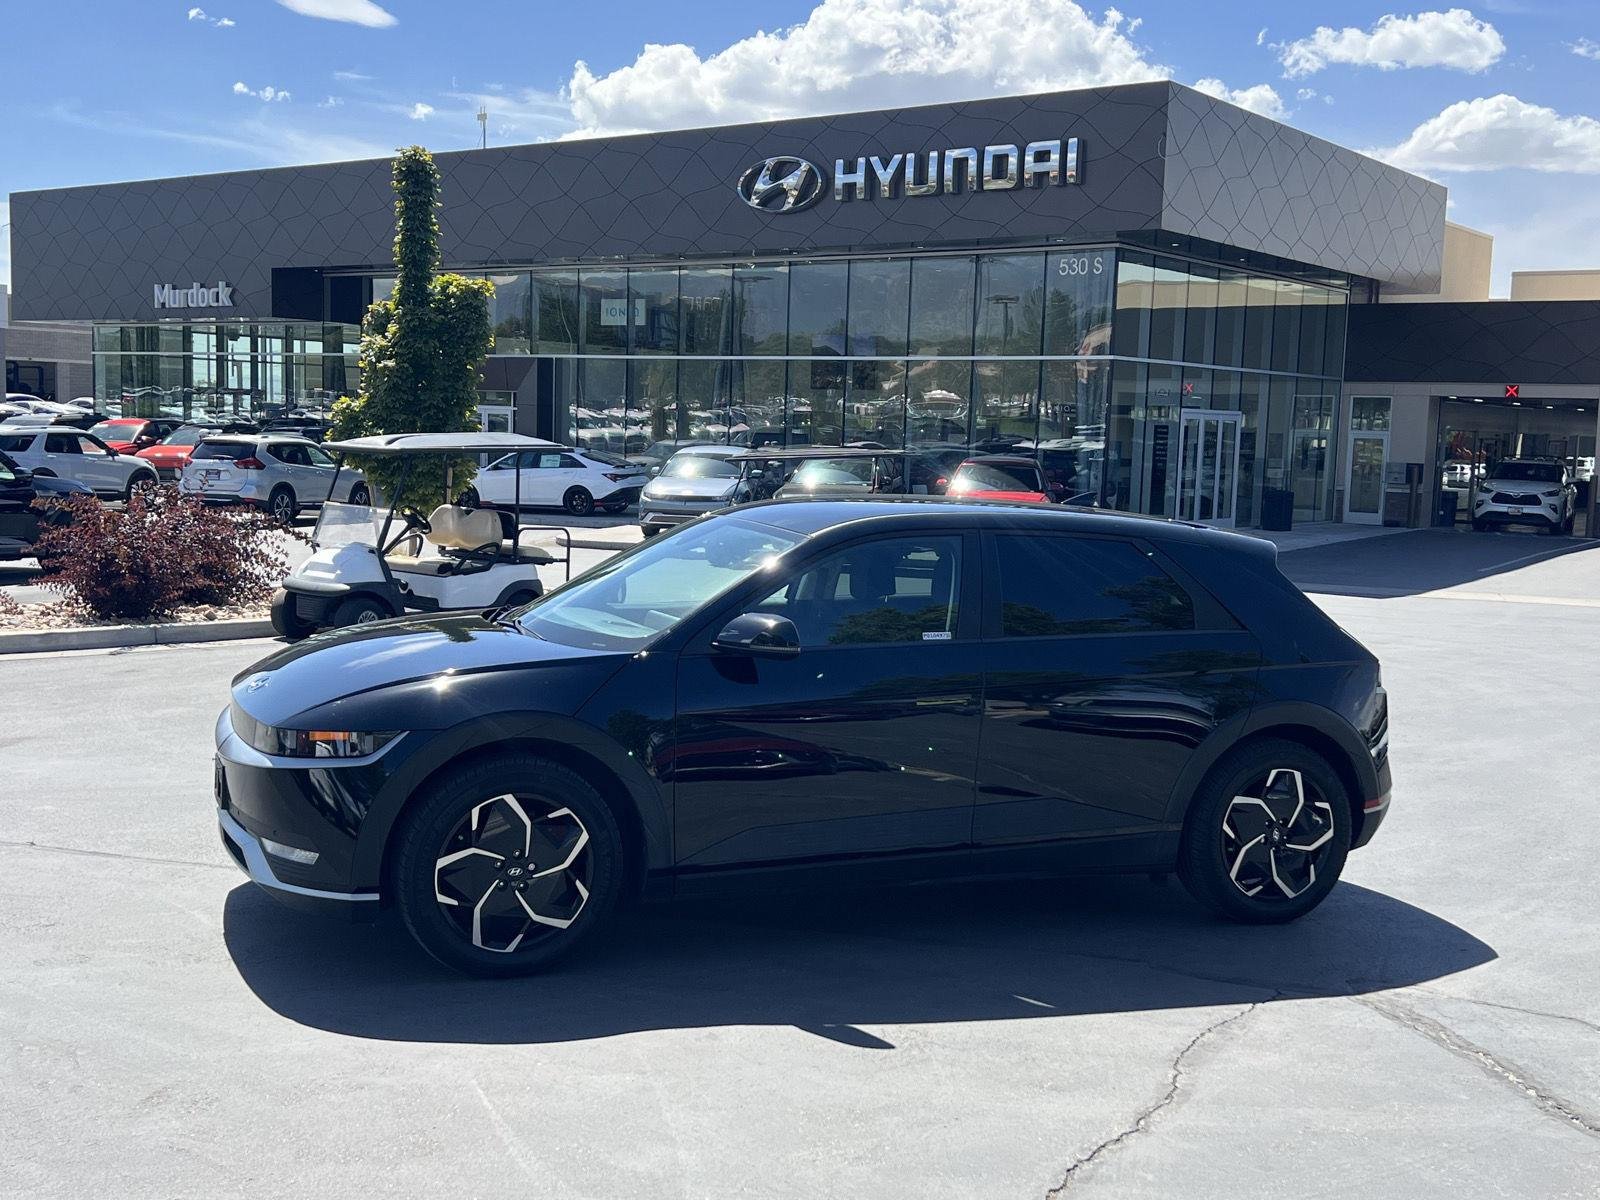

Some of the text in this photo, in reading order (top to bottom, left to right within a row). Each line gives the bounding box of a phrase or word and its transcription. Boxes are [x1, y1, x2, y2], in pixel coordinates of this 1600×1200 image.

[834, 137, 1081, 200] HYUNDAI
[1059, 257, 1103, 275] 530 S
[154, 281, 233, 308] Murdock
